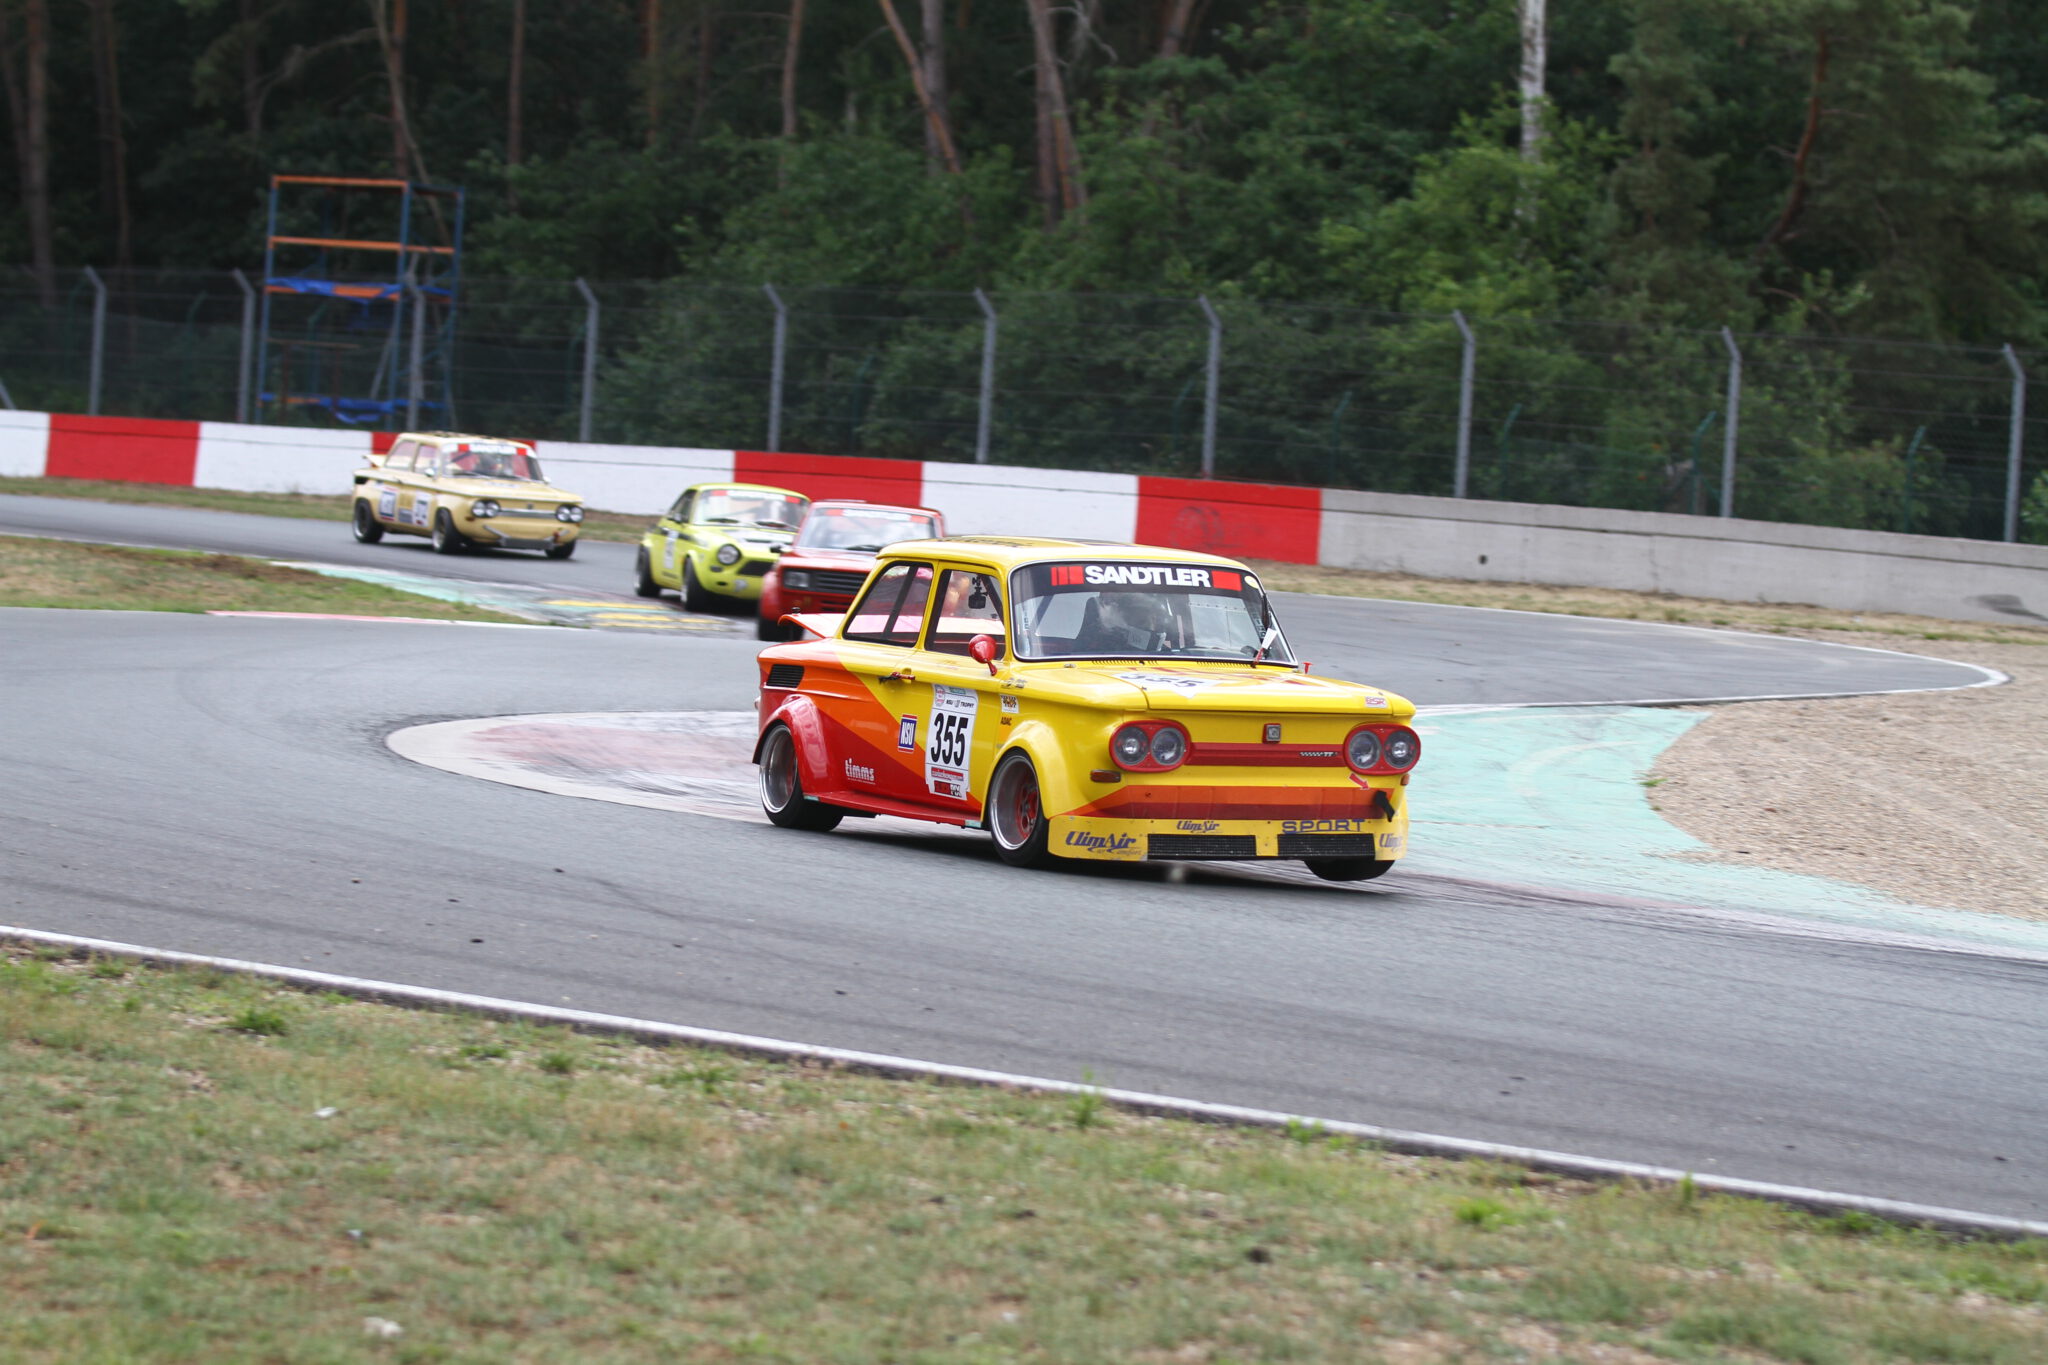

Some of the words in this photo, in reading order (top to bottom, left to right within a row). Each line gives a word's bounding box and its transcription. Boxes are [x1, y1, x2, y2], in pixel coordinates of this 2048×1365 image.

[1085, 564, 1211, 588] SANDTLER
[900, 721, 915, 746] NSU
[930, 712, 968, 767] 355
[845, 757, 875, 782] timms
[1282, 819, 1366, 834] SPORT
[1065, 830, 1137, 852] ClimAir
